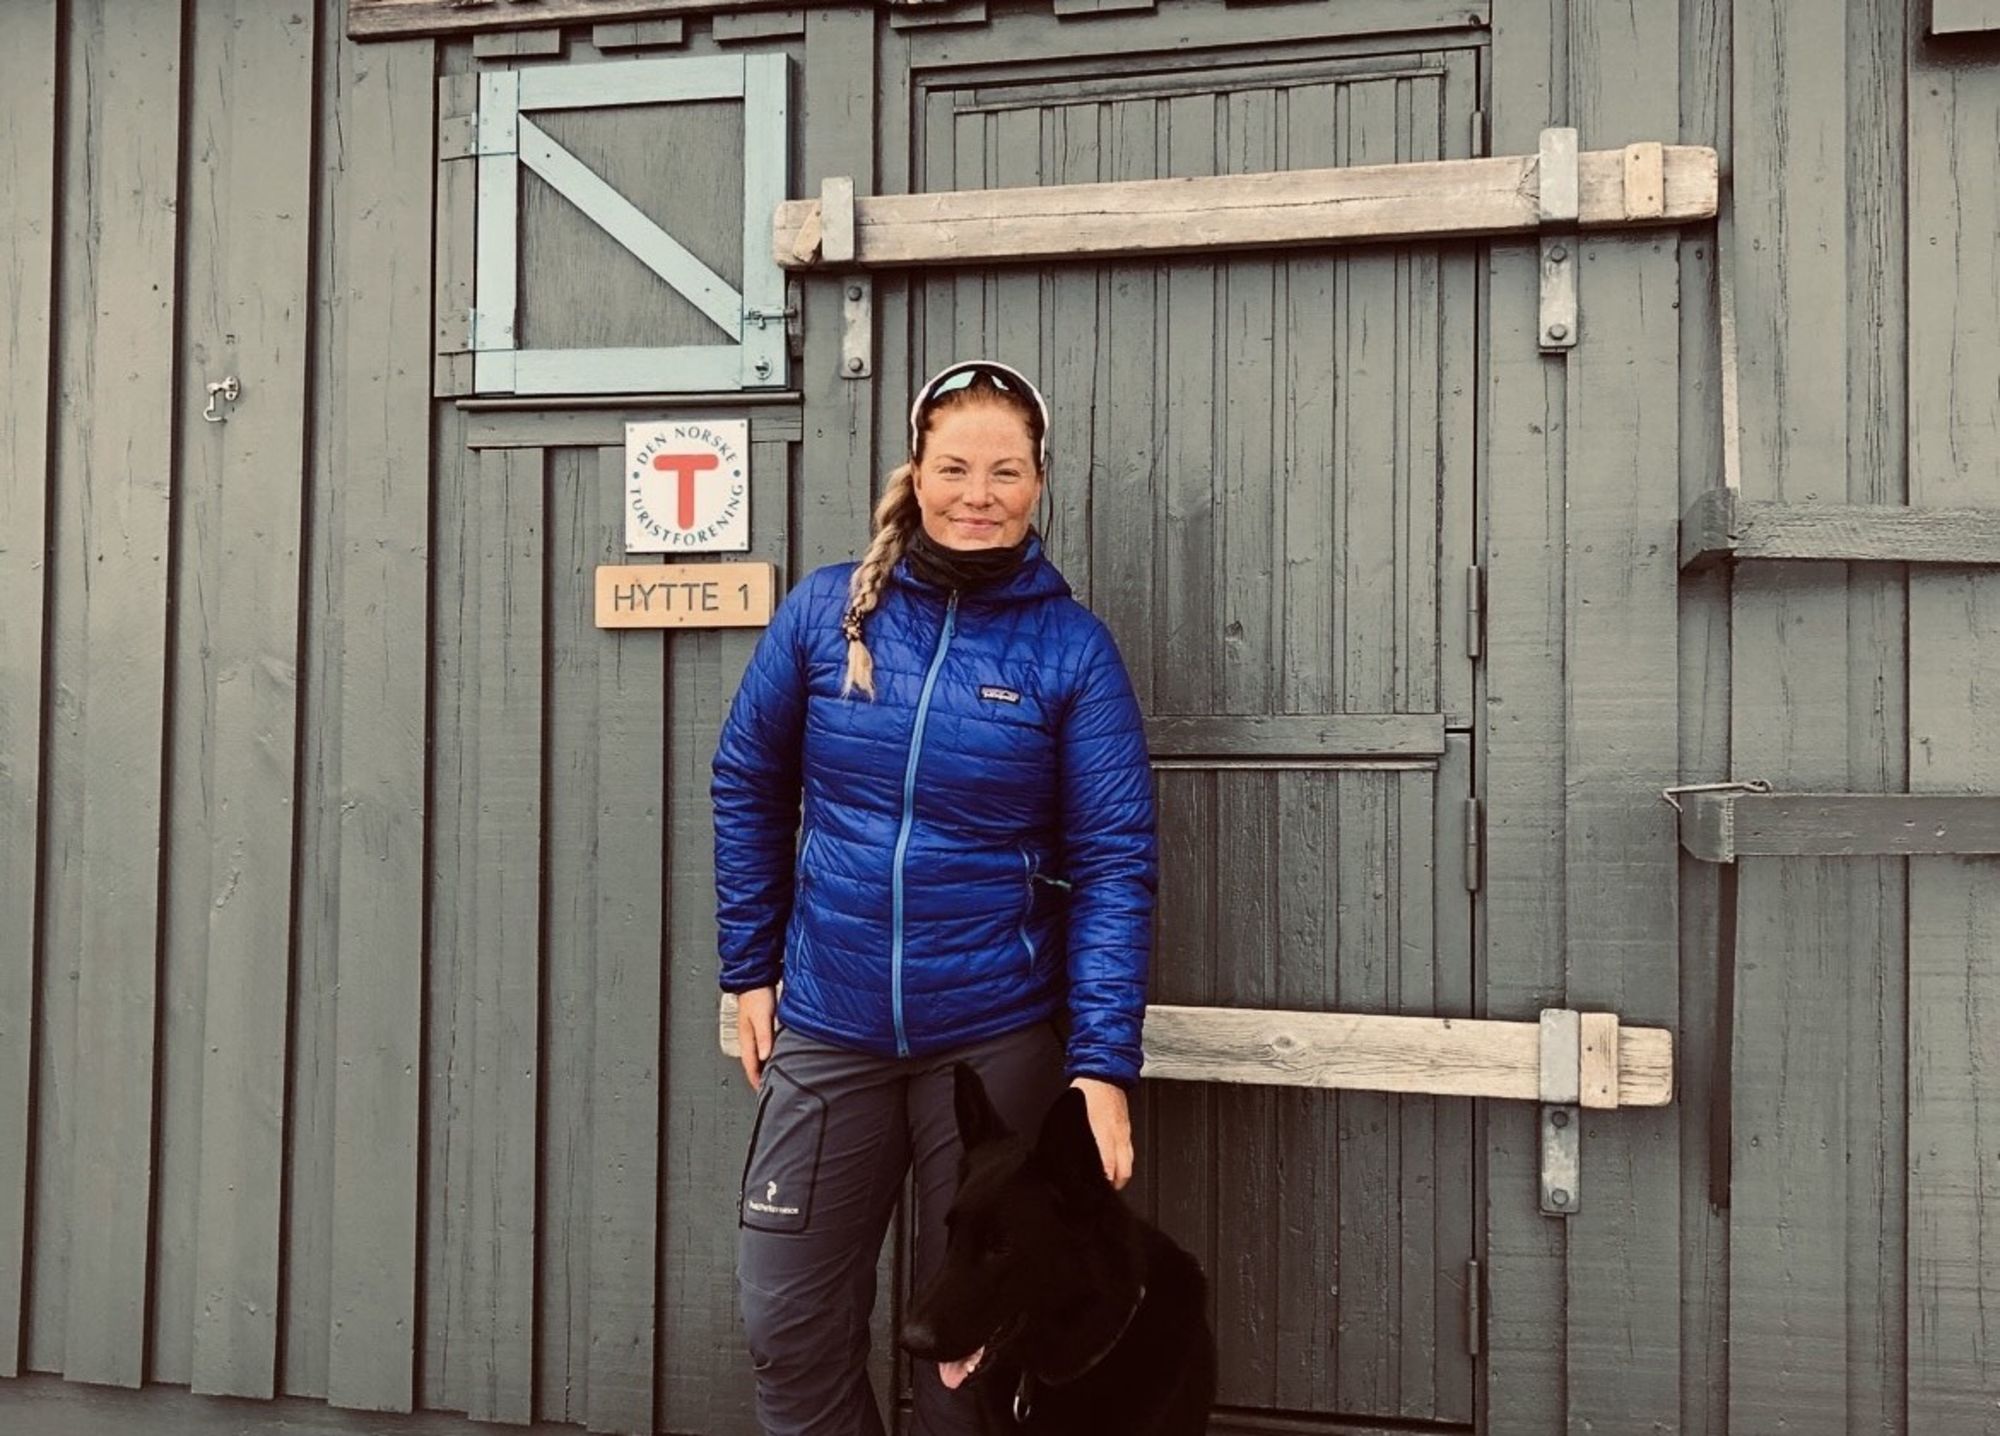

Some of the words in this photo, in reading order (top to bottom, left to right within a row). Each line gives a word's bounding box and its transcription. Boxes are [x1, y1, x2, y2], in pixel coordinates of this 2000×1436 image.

[636, 434, 667, 466] DEN
[674, 426, 738, 463] NORSKE
[630, 484, 744, 547] TURISTFORENING
[653, 454, 719, 531] T
[614, 582, 719, 611] HYTTE
[738, 583, 749, 611] 1
